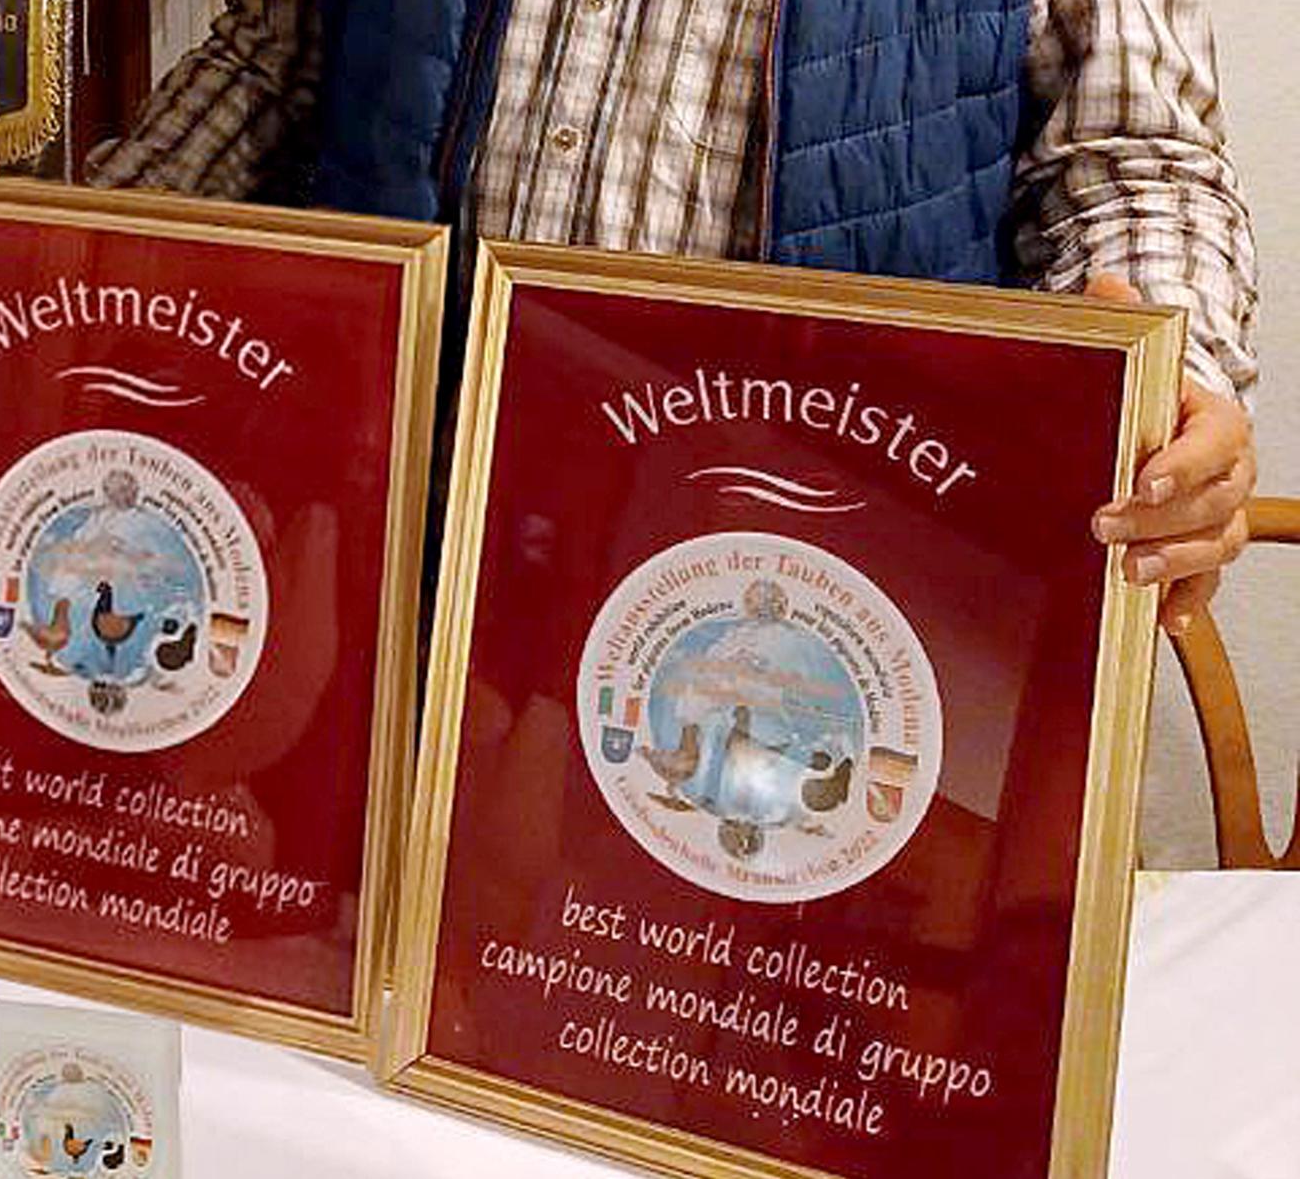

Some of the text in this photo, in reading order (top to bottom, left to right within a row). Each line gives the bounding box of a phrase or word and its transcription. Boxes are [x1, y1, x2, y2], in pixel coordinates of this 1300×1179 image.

[601, 368, 977, 496] Weltmeister
[723, 549, 762, 571] der
[26, 771, 105, 809] world
[115, 785, 250, 838] collection
[32, 825, 160, 874] mondiale
[171, 844, 200, 882] di
[208, 862, 316, 914] gruppo
[100, 894, 232, 944] mondiale
[562, 888, 910, 1011] best world collection
[481, 939, 992, 1103] campione mondiale di gruppo
[559, 1018, 884, 1135] collection mondiale
